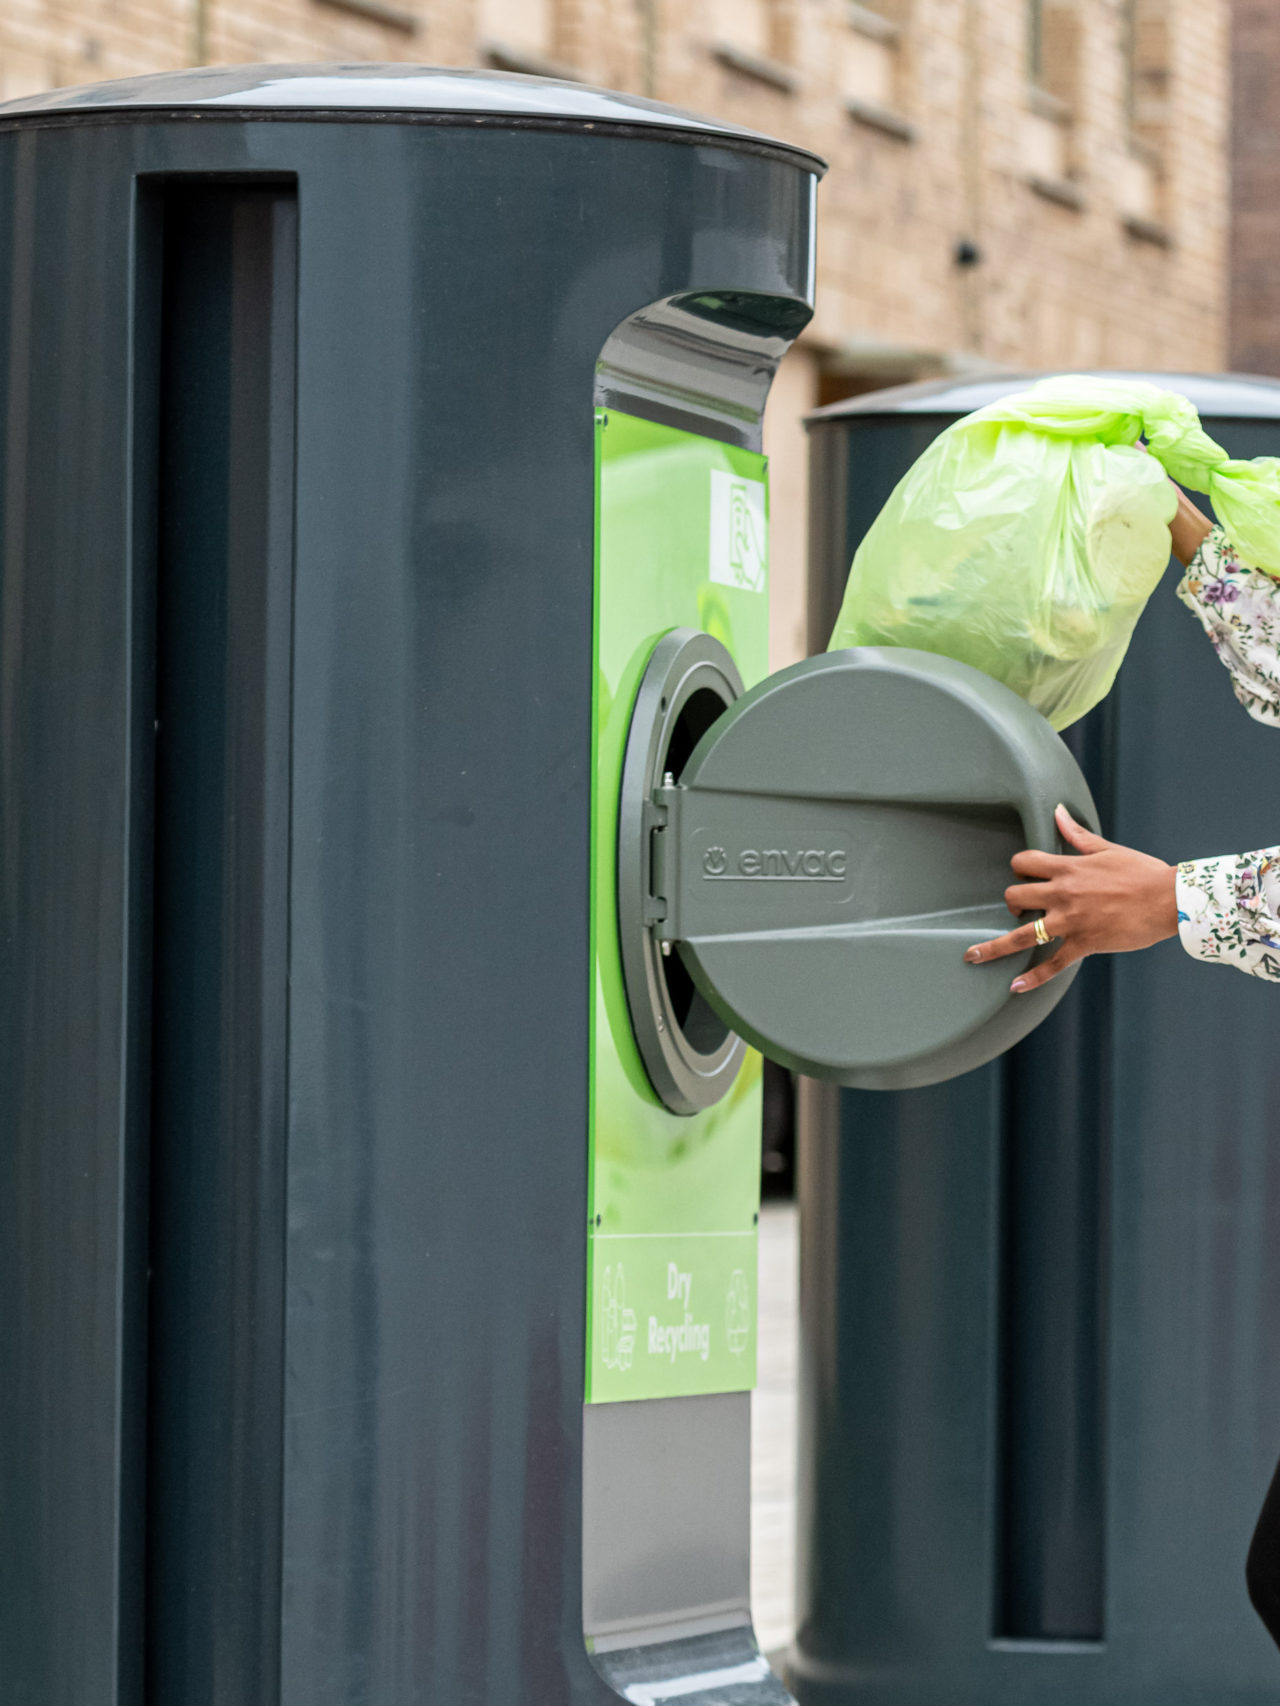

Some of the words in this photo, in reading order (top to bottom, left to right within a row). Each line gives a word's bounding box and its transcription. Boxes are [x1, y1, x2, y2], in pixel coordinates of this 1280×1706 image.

[739, 849, 846, 877] envac
[667, 1261, 693, 1310] Dry
[648, 1311, 710, 1364] Recycling
